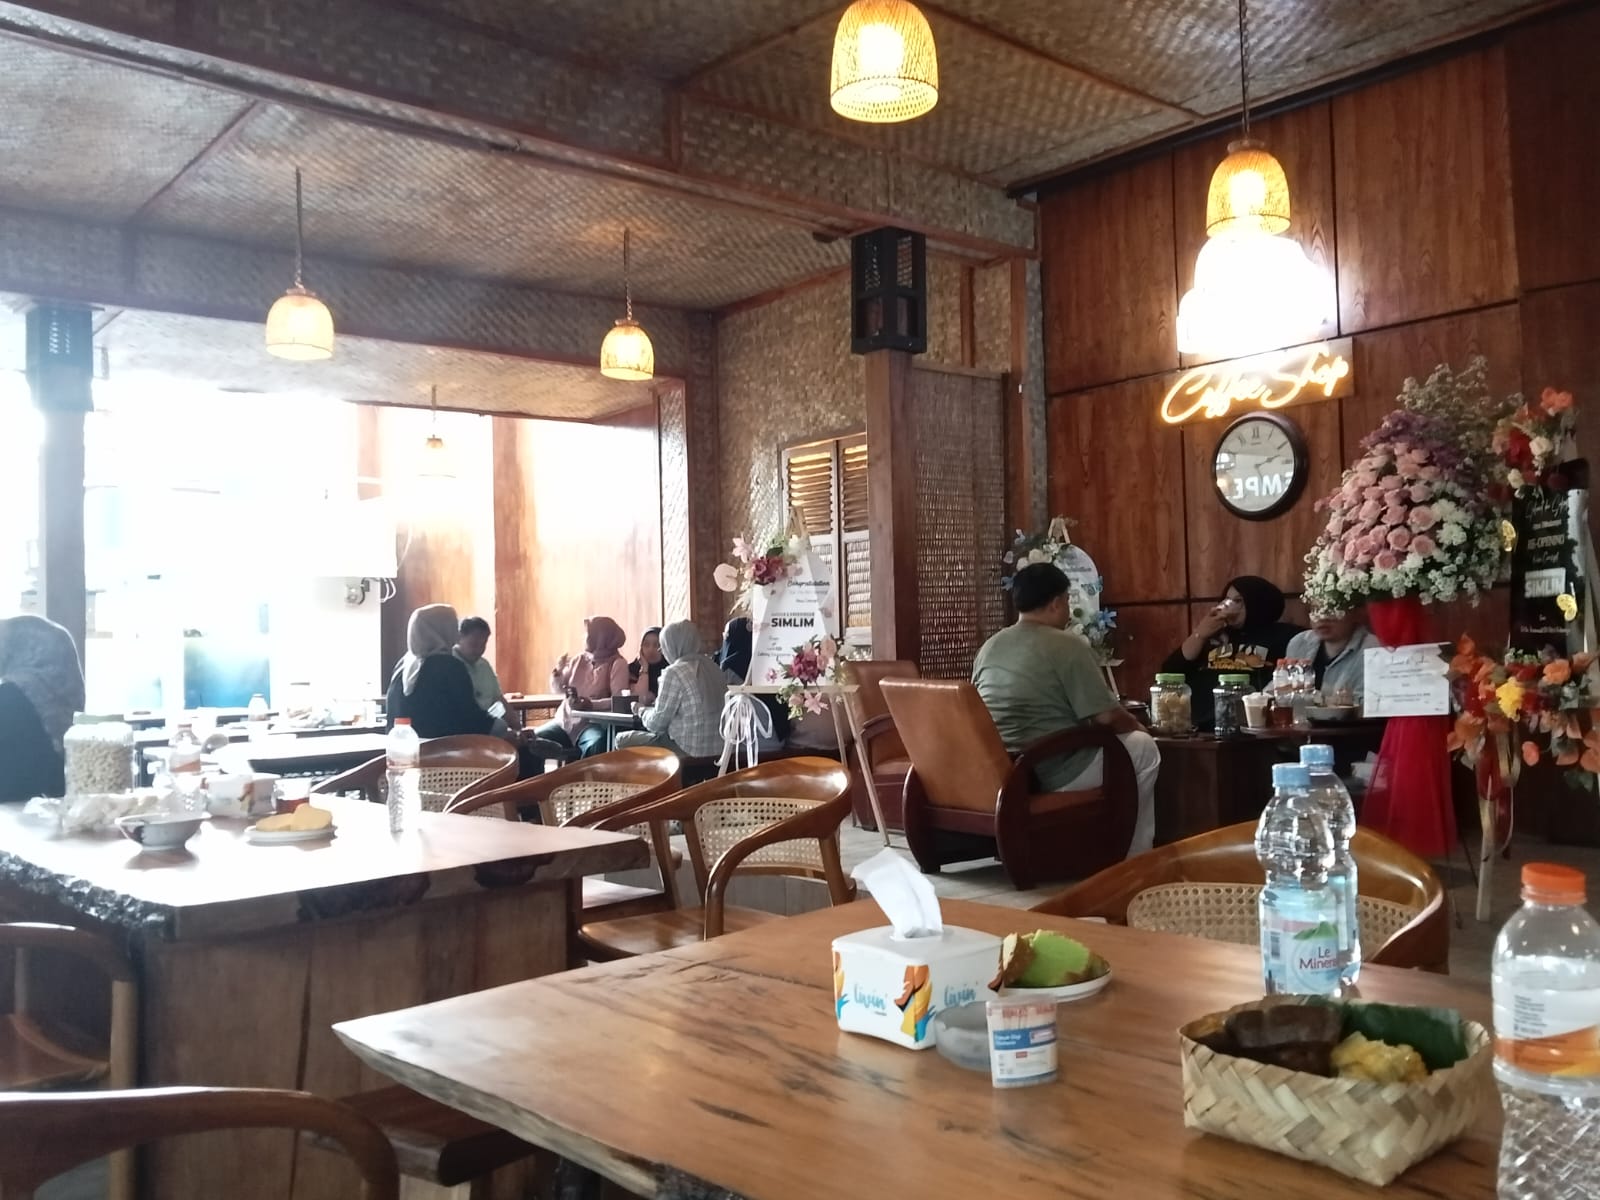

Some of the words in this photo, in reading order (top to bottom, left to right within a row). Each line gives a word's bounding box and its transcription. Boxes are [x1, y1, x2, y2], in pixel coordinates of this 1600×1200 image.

[1261, 350, 1349, 409] Shop
[771, 617, 814, 628] SIMLIM
[1318, 946, 1331, 958] Le
